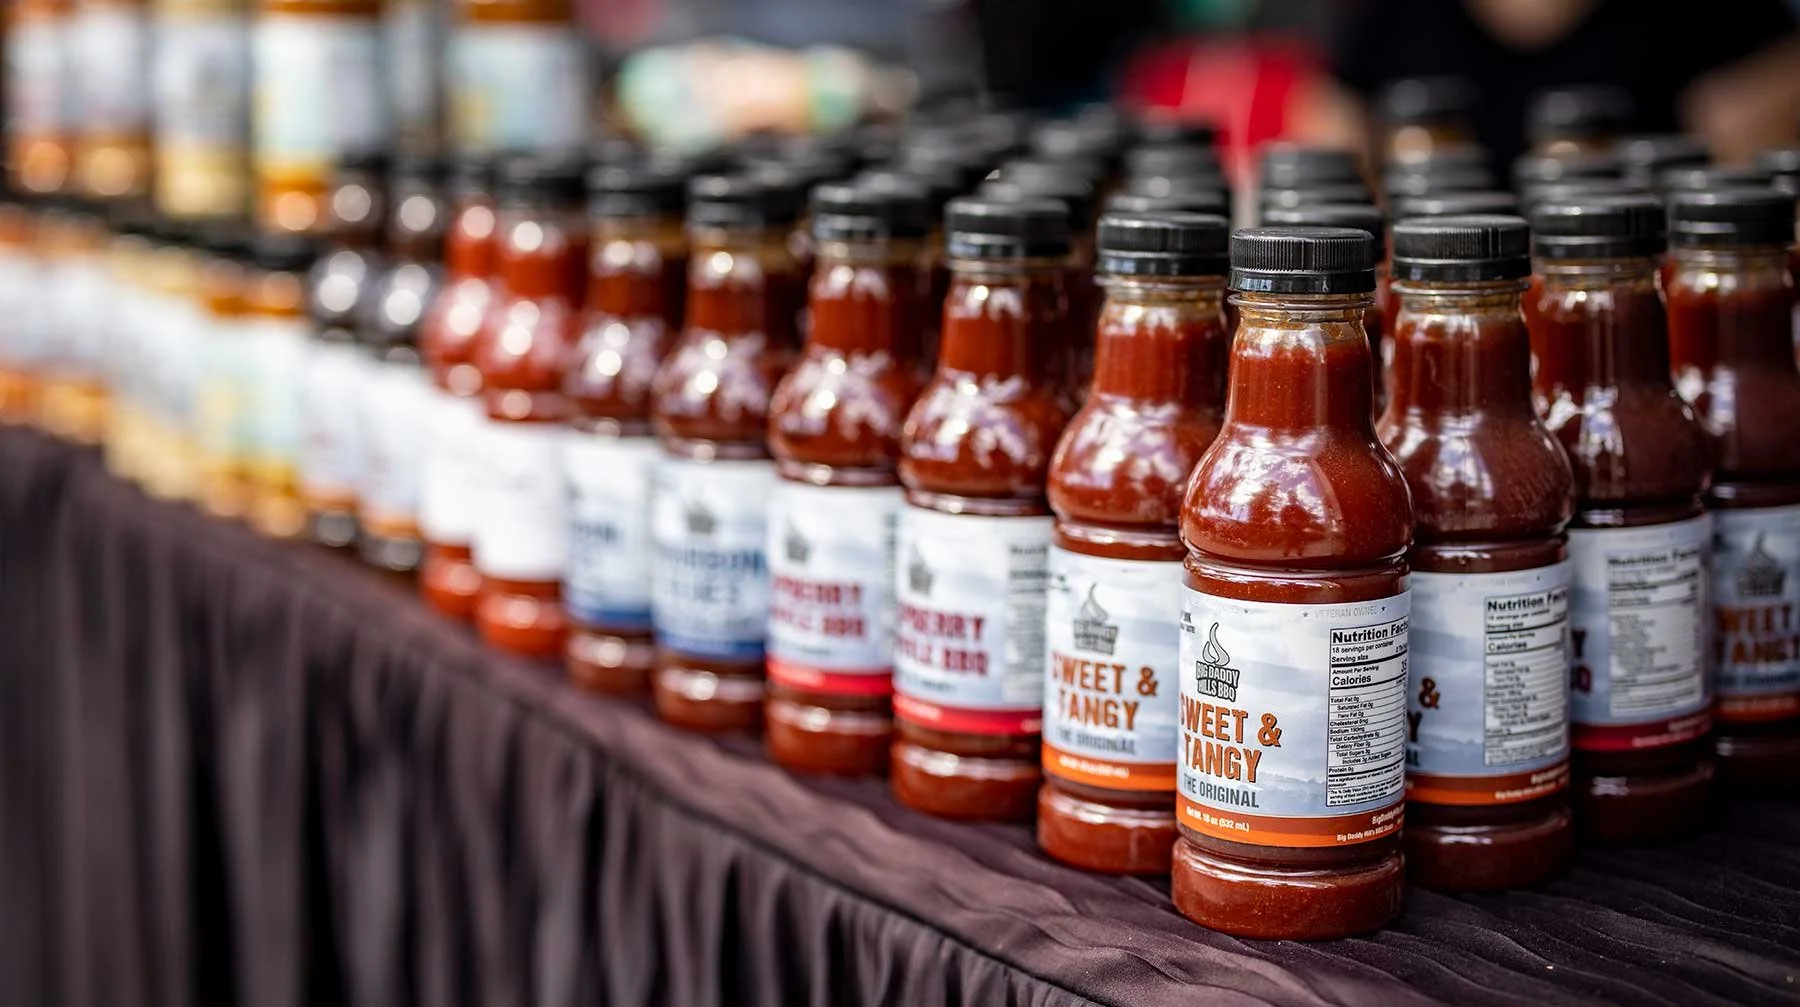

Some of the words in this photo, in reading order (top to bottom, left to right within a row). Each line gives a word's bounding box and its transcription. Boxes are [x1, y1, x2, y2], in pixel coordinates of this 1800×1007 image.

[1488, 597, 1544, 611] Nutrition
[1332, 628, 1387, 643] Nutrition
[1391, 621, 1408, 636] Facts
[1341, 645, 1364, 653] servings
[1375, 640, 1394, 649] container
[1488, 642, 1527, 651] Calories
[1053, 651, 1125, 694] SWEET
[1137, 666, 1159, 696] &
[1209, 664, 1240, 688] DADDY
[1332, 675, 1371, 686] Calories
[1217, 682, 1236, 702] BBQ
[1418, 677, 1440, 709] &
[1059, 688, 1139, 730] TANGY
[1181, 692, 1248, 744] SWEET
[1258, 713, 1282, 747] &
[1343, 733, 1374, 741] Carbohydrate
[1185, 733, 1262, 783] TANGY
[1184, 773, 1196, 794] THE
[1200, 781, 1259, 808] ORIGINAL
[1347, 832, 1363, 840] Daddy
